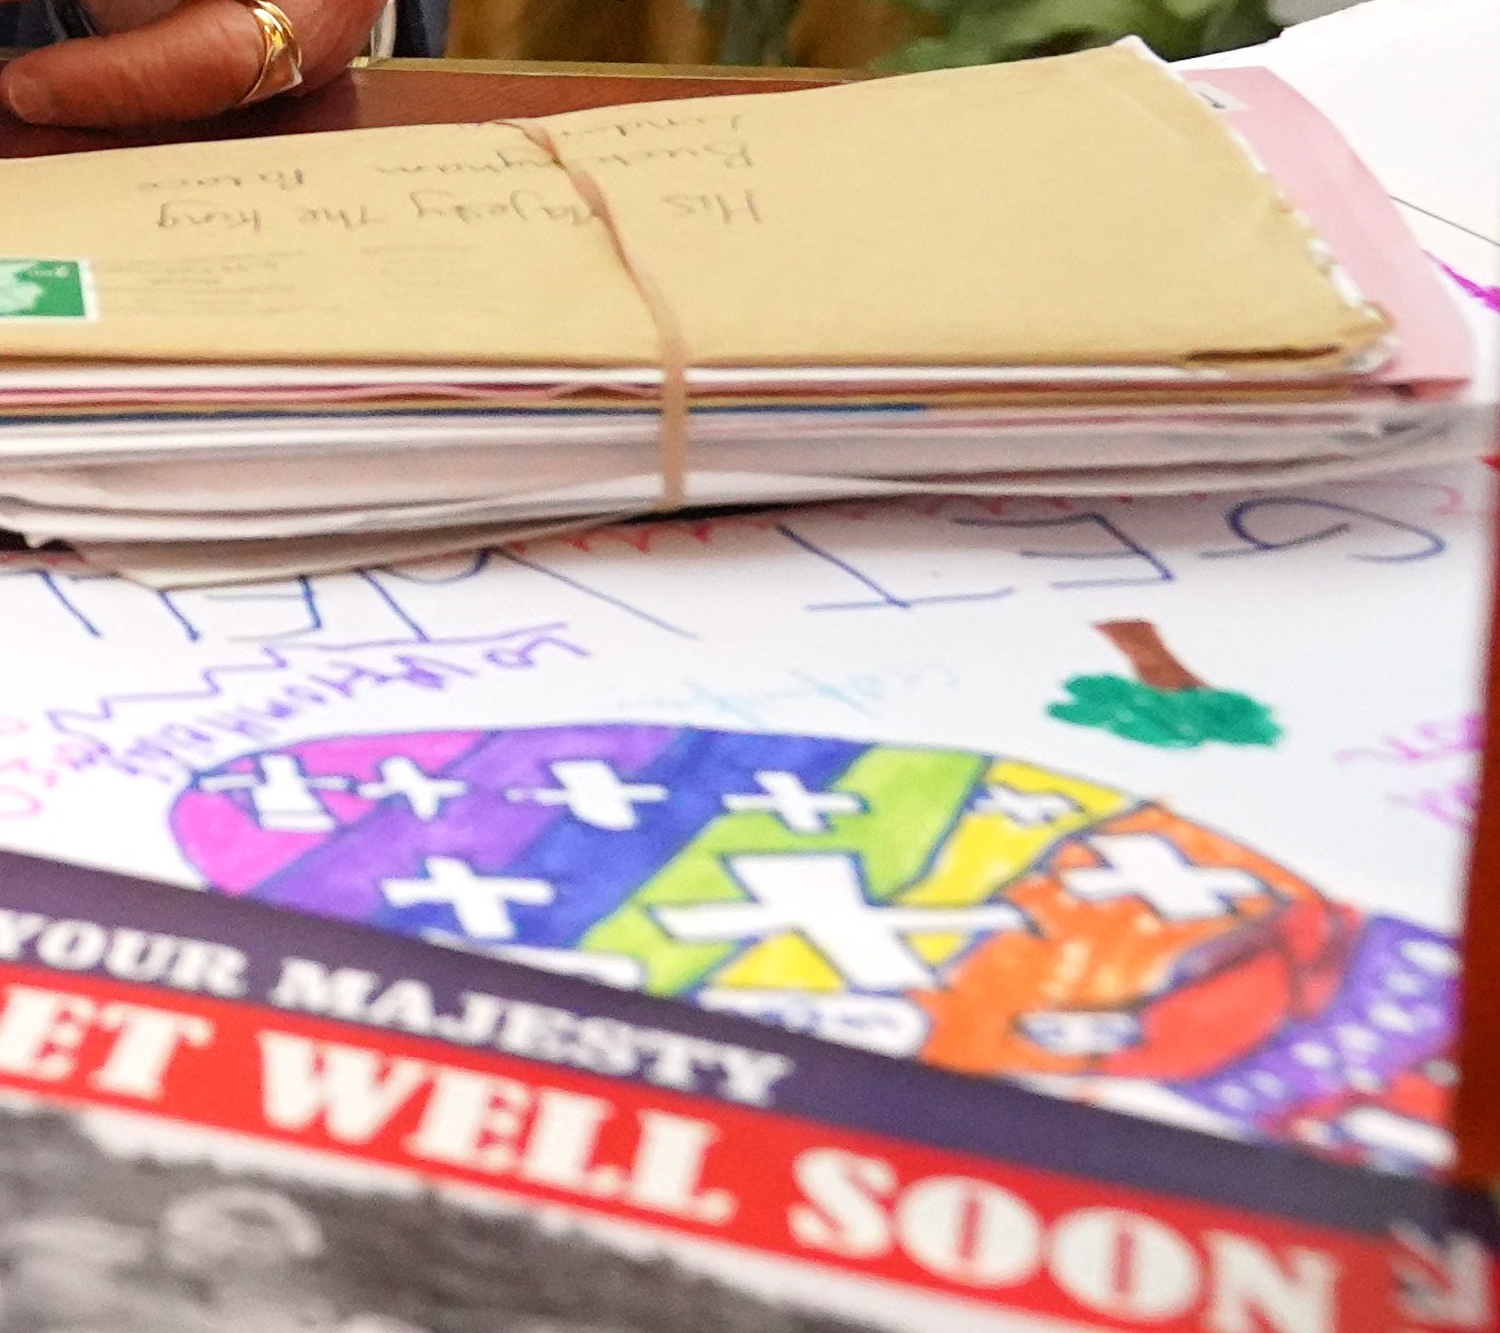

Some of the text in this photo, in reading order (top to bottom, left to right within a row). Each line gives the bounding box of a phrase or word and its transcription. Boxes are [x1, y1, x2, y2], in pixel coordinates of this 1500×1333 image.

[777, 495, 1446, 613] GET
[272, 955, 794, 1109] MAJESTY
[255, 1027, 737, 1225] WELL
[788, 1145, 1342, 1333] SOON
